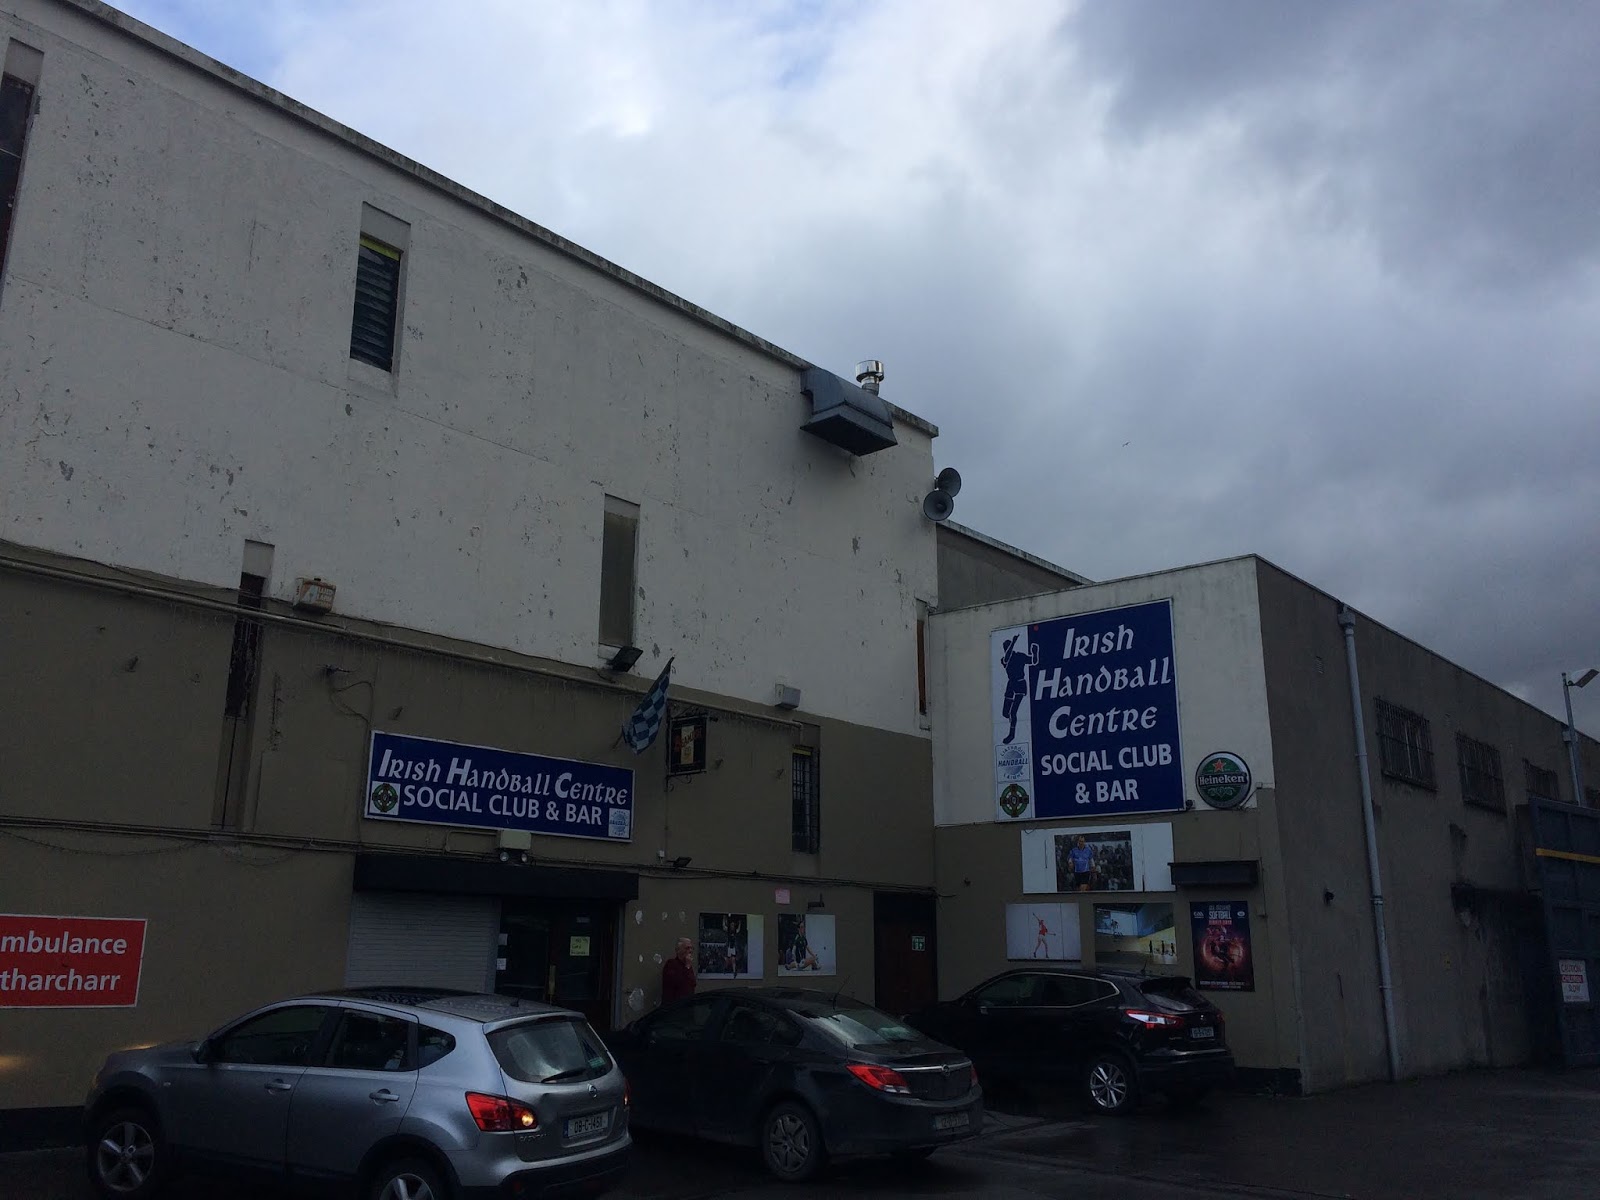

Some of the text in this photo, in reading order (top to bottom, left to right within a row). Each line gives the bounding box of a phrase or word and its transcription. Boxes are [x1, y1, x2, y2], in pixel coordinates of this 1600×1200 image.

[1063, 624, 1134, 660] Irish
[1034, 656, 1172, 700] Handball
[1048, 706, 1158, 739] Centre
[998, 758, 1029, 767] HANDBALL
[1041, 743, 1173, 775] SOCIAL CLUB
[378, 749, 628, 805] Irish Handball Centre
[1074, 779, 1139, 804] & BAR
[1199, 774, 1246, 786] Heineken
[403, 784, 602, 825] SOCIAL CLUB & BAR
